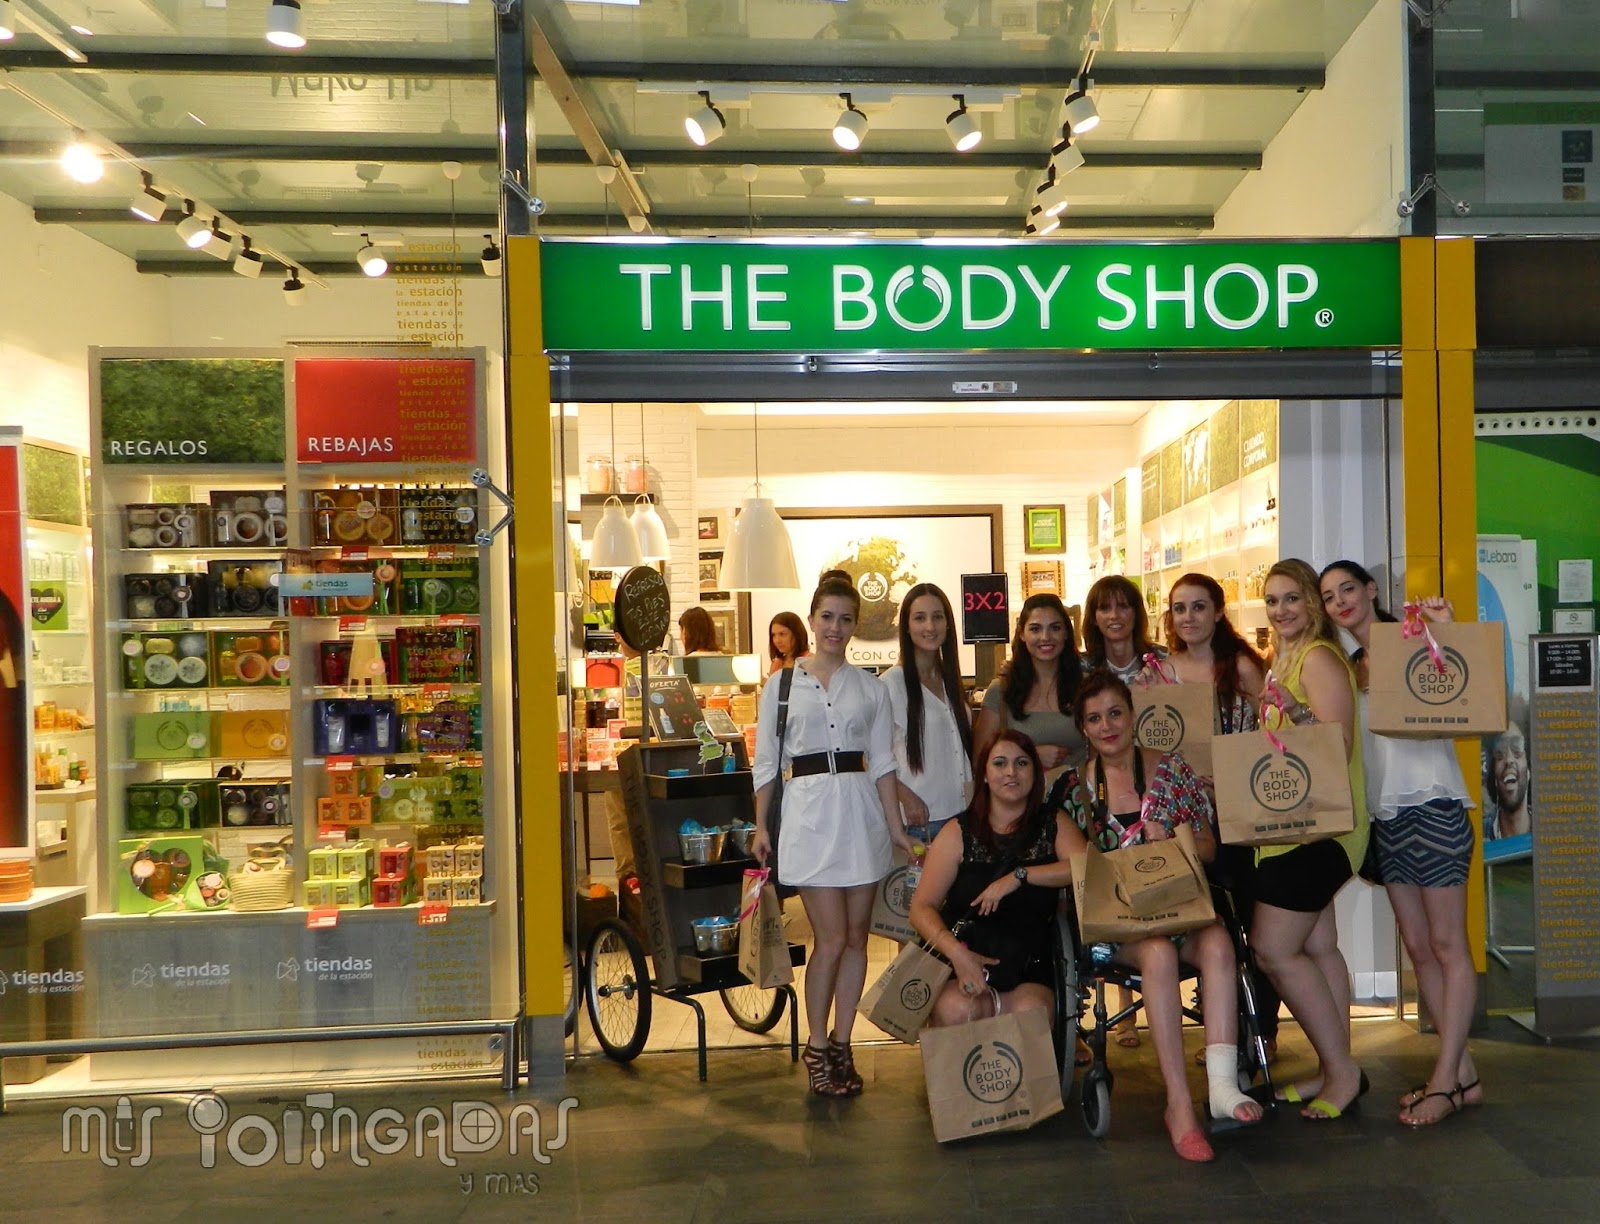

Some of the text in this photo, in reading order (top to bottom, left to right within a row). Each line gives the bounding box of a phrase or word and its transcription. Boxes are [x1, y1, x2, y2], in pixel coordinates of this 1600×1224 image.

[409, 242, 461, 251] estación
[409, 286, 462, 297] estación
[619, 262, 1319, 332] THE BODY SHOP
[397, 299, 432, 307] tiendas
[398, 319, 448, 329] tiendas
[410, 331, 464, 341] estación
[400, 364, 449, 374] tiendas
[412, 376, 465, 386] estación
[400, 409, 450, 419] tiendas
[413, 420, 466, 431] estación
[111, 440, 208, 456] REGALOS
[308, 437, 394, 456] REBAJAS
[1486, 550, 1517, 563] Lebara
[315, 580, 348, 588] tiendas
[645, 593, 665, 611] PIES
[964, 592, 1005, 611] 3X2
[852, 651, 882, 660] CON
[650, 680, 680, 688] OFERTA
[1418, 673, 1456, 684] BODY
[1420, 684, 1454, 694] SHOP
[1153, 720, 1168, 728] THE
[1549, 720, 1597, 729] estación
[1145, 728, 1175, 737] BODY
[1147, 738, 1174, 746] SHOP
[1538, 751, 1583, 760] tiendas
[1550, 761, 1598, 770] estación
[1269, 770, 1290, 779] THE
[1263, 779, 1299, 791] BODY
[1266, 790, 1299, 801] SHOP
[1552, 804, 1599, 813] estación
[304, 957, 373, 972] tiendas
[160, 962, 230, 979] tiendas
[331, 973, 338, 981] la
[340, 970, 373, 980] estación
[12, 968, 85, 985] tiendas
[175, 976, 231, 988] de la estación
[28, 982, 85, 993] de la estación
[418, 1048, 467, 1059] tiendas
[431, 1058, 483, 1071] estación
[981, 1059, 1001, 1071] THE
[975, 1068, 1011, 1084] BODY
[979, 1080, 1012, 1094] SHOP
